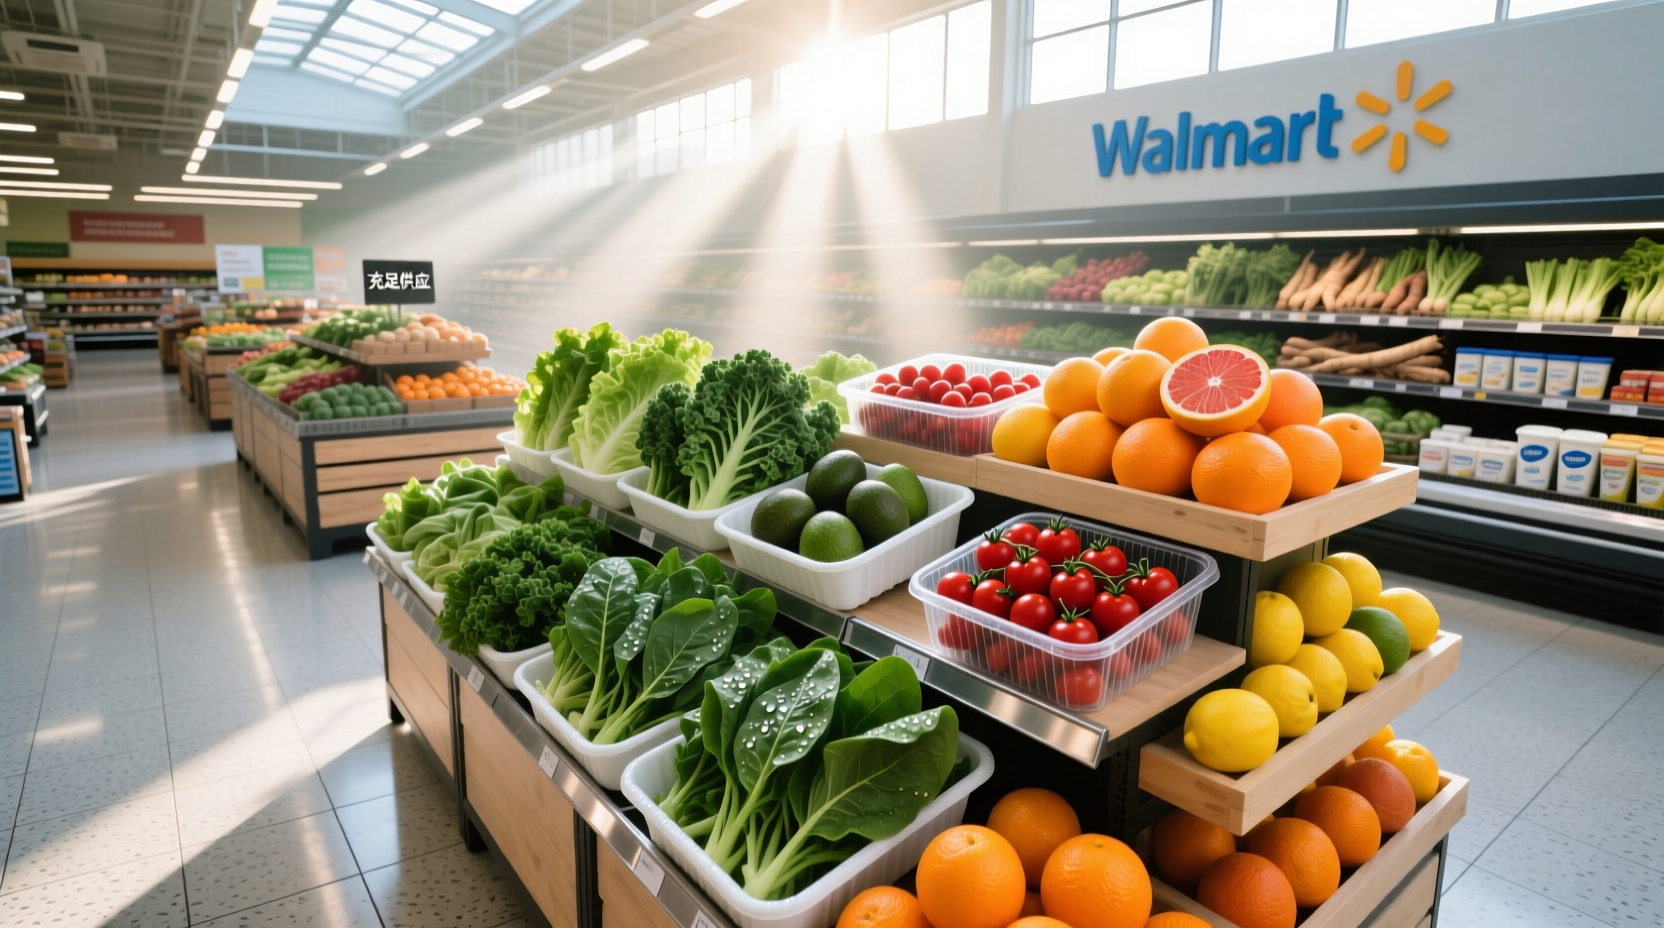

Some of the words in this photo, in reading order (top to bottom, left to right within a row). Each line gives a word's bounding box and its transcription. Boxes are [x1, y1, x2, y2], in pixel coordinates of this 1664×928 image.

[1092, 93, 1343, 177] Walmart
[367, 271, 431, 290] 充足供应
